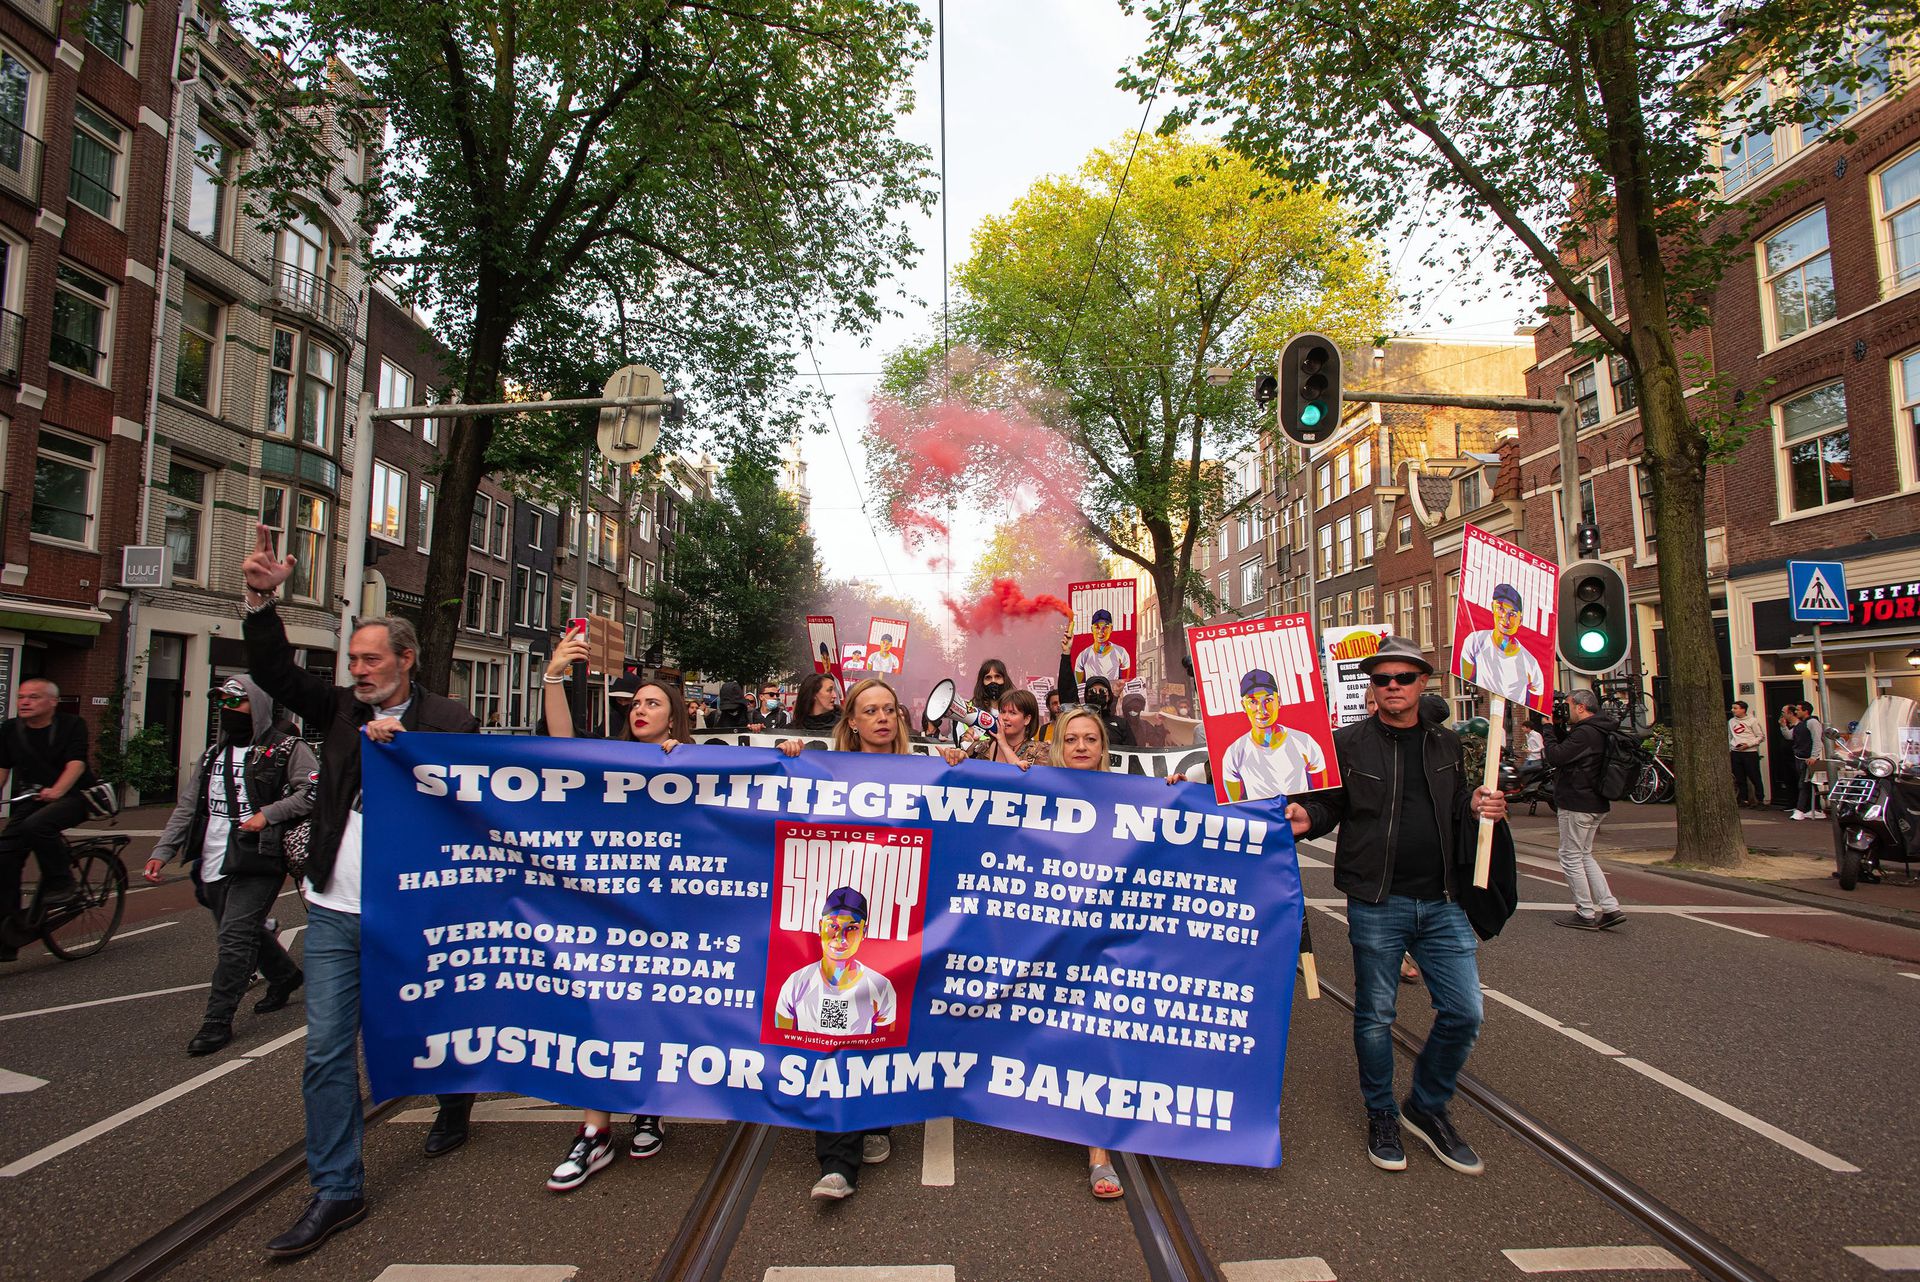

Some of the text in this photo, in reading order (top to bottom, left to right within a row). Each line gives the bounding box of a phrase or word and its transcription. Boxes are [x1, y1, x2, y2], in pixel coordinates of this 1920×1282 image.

[128, 564, 159, 576] WULF
[1470, 529, 1556, 575] JUSTICE FOR
[1072, 580, 1135, 592] JUSTICE FOR
[1195, 616, 1306, 640] JUSTICE FOR
[1861, 596, 1920, 625] JOR
[413, 764, 1268, 855] STOP POLITIEGEWELD NU!!!
[489, 829, 682, 848] SAMMY VROEG:
[787, 828, 924, 846] JUSTICE FOR
[441, 844, 728, 873] "KANN ICH EINEN ARZT
[980, 851, 1238, 896] O.M. HOUDT AGENTEN
[398, 867, 769, 898] HABEN?" EN KREEG 4 KOGELS!
[779, 837, 924, 942] SAMMY
[956, 873, 1256, 922] HAND BOVEN HET HOOFD
[423, 920, 741, 954] VERMOORD DOOR L+S
[948, 896, 1260, 946] EN REGERING KIJKT WEG!!
[427, 946, 736, 981] POLITIE AMSTERDAM
[945, 953, 1255, 1004] HOEVEEL SLACHTOFFERS
[399, 971, 756, 1009] OP 13 AUGUSTUS 2020!!!
[943, 976, 1249, 1029] MOETEN ER NOG VALLEN
[929, 998, 1256, 1055] DOOR POLITIEKNALLEN??
[413, 1026, 1235, 1132] JUSTICE FOR SAMMY BAKER!!!
